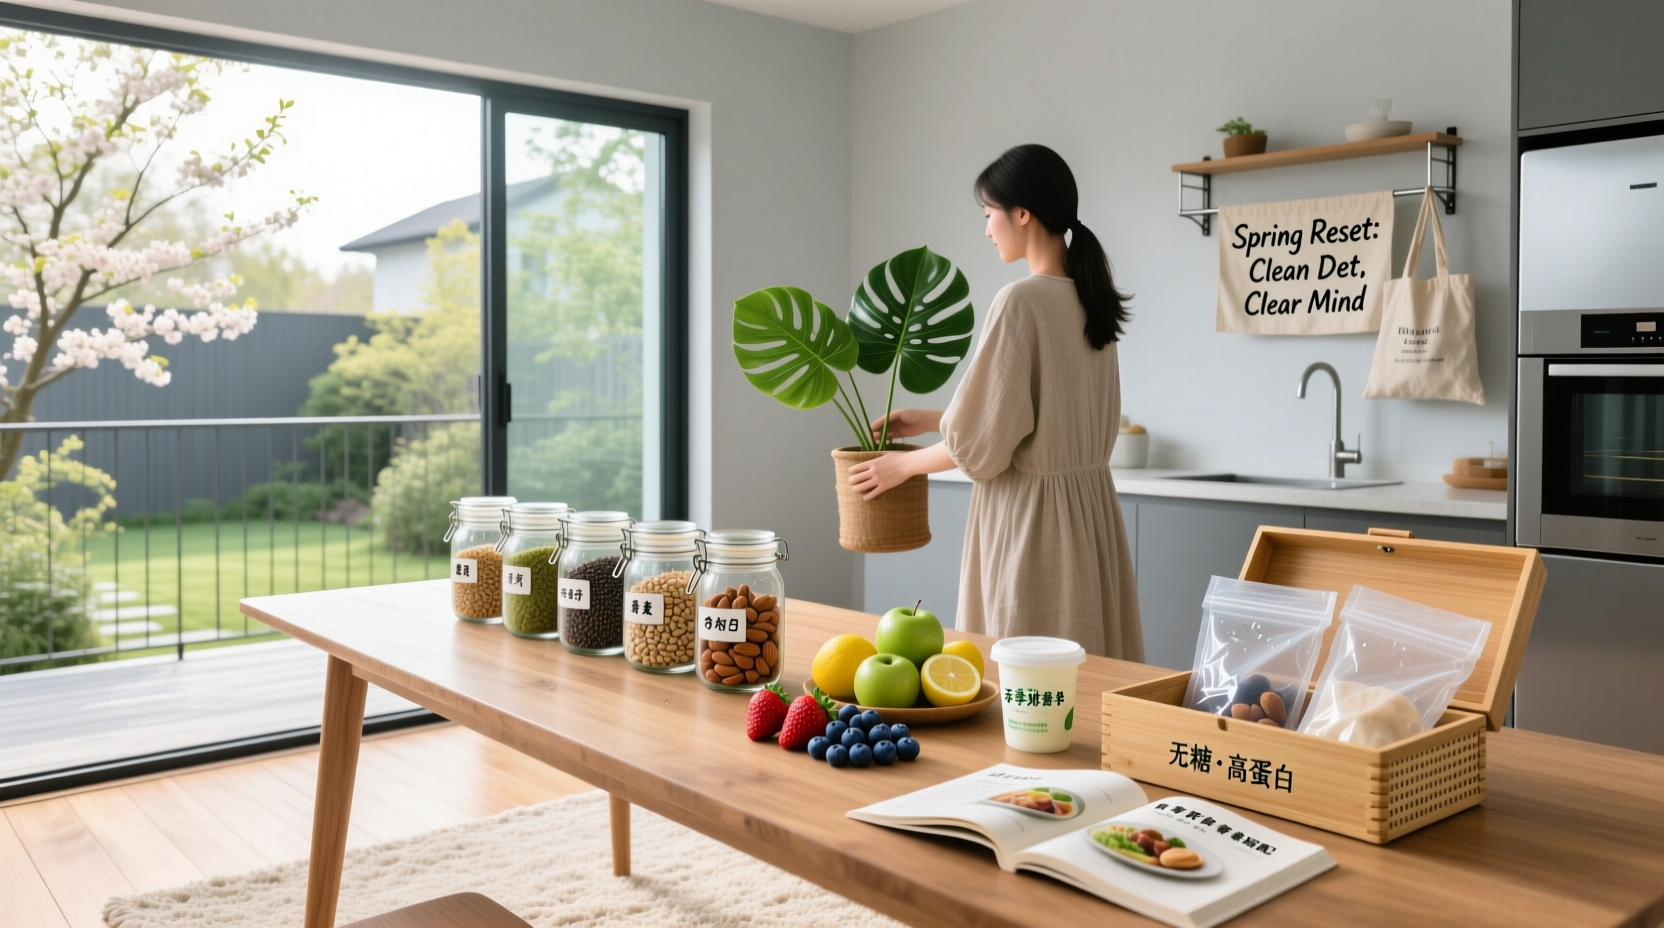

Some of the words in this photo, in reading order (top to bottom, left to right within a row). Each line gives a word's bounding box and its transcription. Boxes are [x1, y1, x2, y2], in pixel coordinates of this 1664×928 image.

[1232, 223, 1303, 257] Spring
[1310, 217, 1380, 245] Reset:
[1249, 257, 1309, 283] Clean
[1317, 254, 1366, 280] Det,
[1244, 290, 1302, 316] Clear
[1307, 284, 1367, 314] Mind
